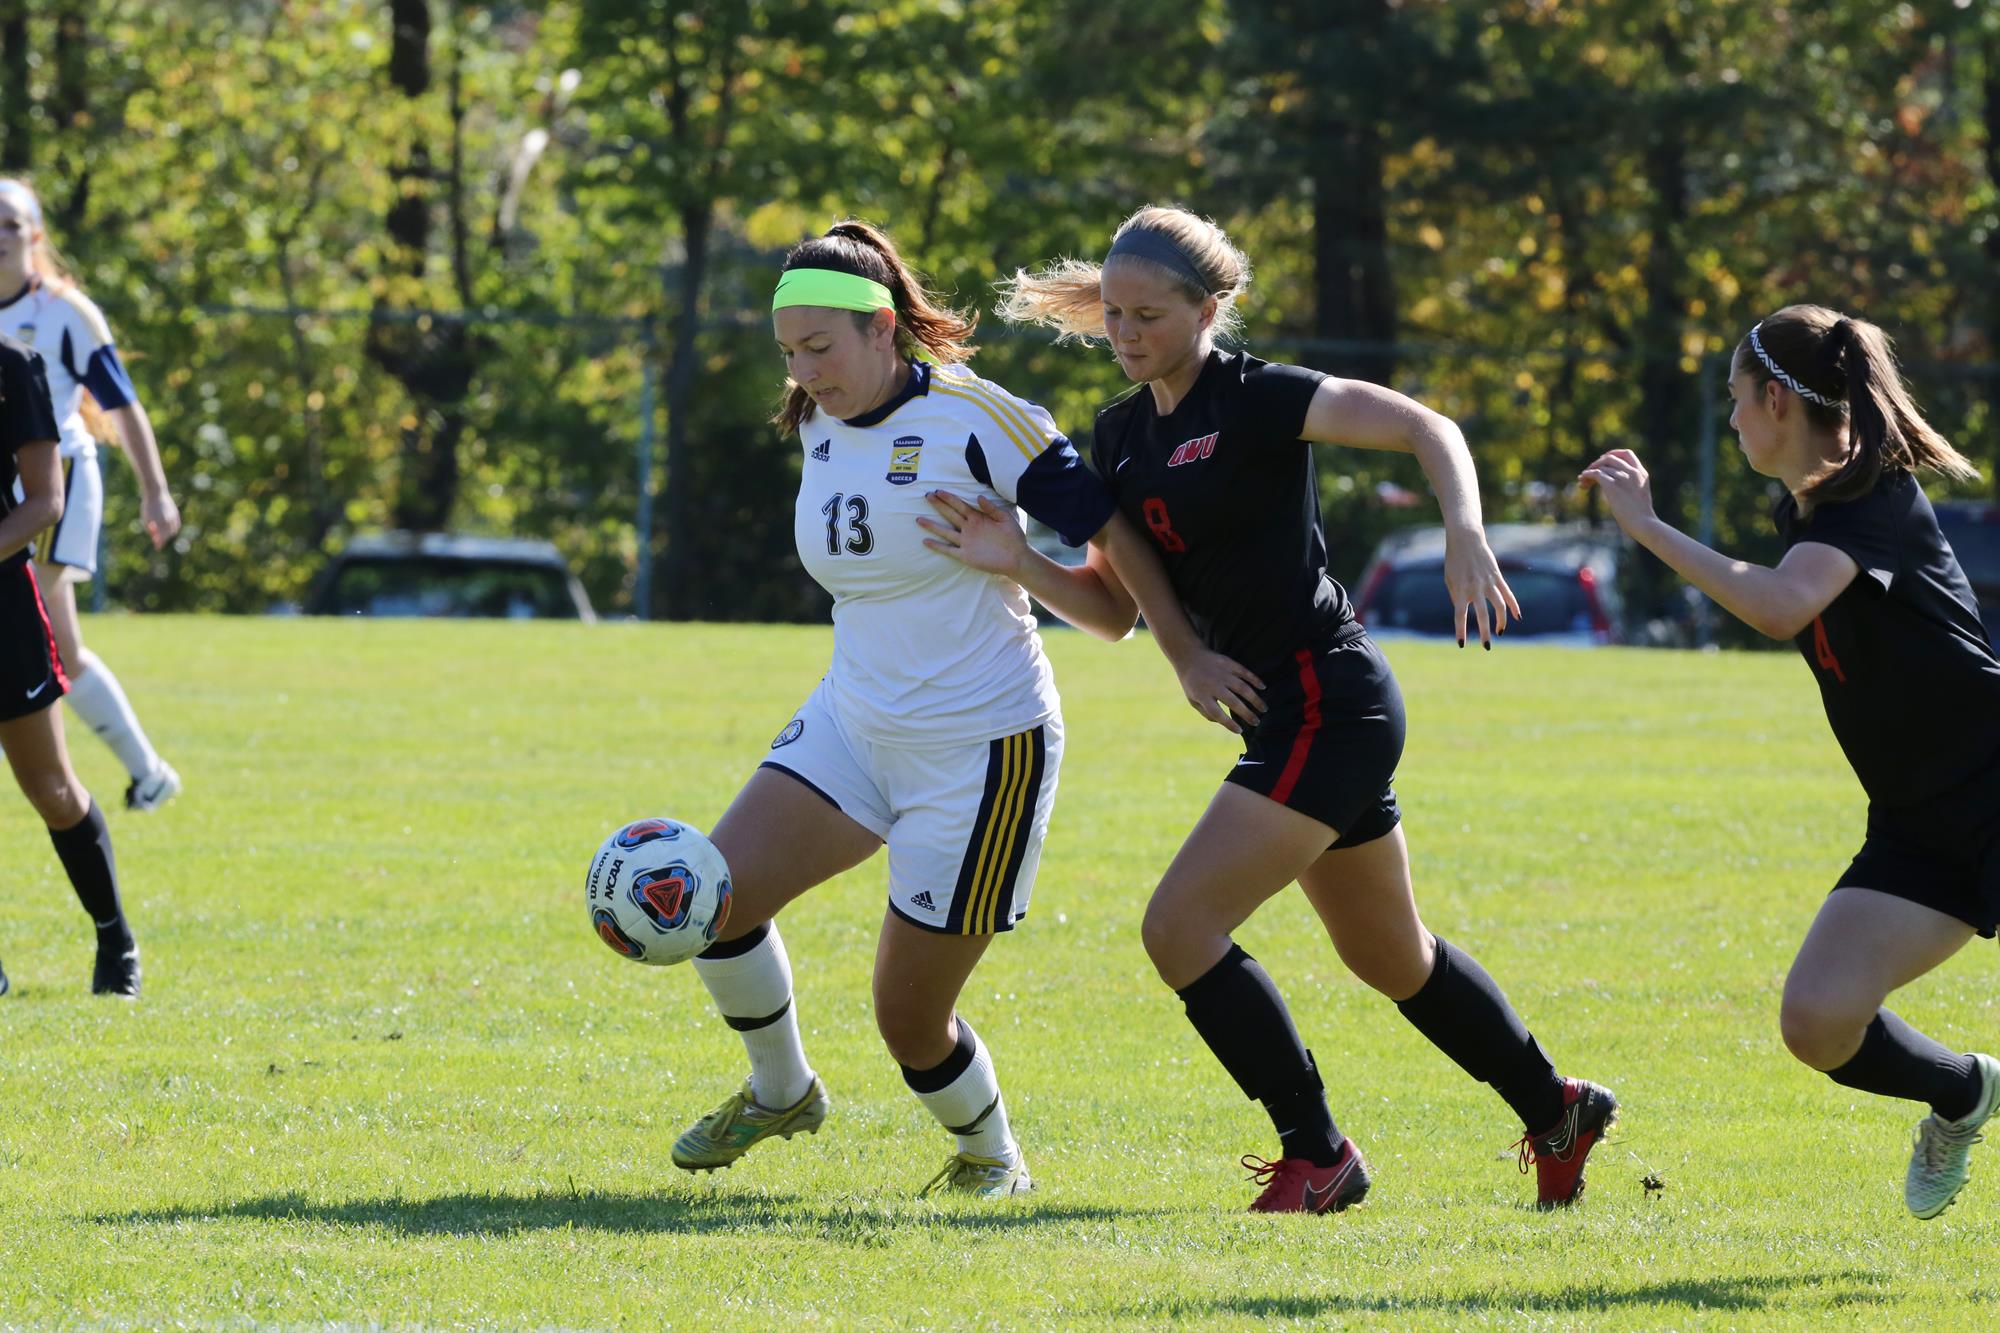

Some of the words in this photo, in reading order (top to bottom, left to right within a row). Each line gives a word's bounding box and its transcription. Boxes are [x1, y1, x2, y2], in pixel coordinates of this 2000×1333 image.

[811, 450, 830, 462] adidas
[821, 492, 874, 556] 13
[1142, 498, 1187, 553] 8
[1813, 614, 1846, 682] 4
[590, 852, 609, 900] Wilson
[604, 859, 625, 901] NCAA
[910, 896, 936, 912] adidas
